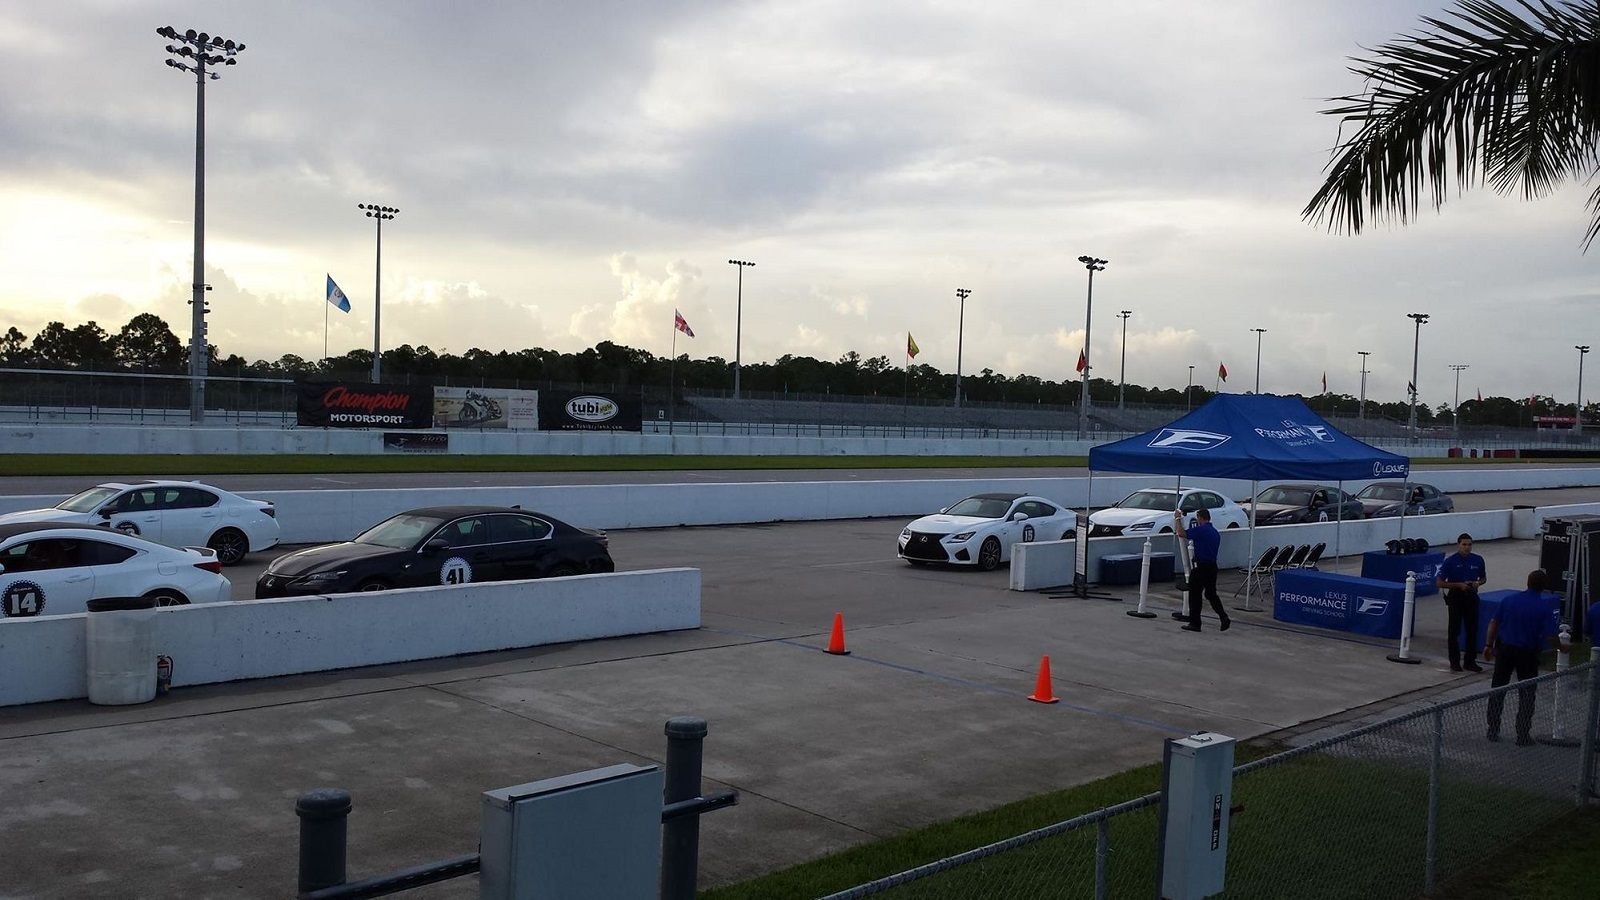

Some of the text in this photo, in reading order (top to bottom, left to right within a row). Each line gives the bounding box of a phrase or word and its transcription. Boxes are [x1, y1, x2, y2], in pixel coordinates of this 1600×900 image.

[323, 386, 409, 414] Champion
[571, 401, 599, 414] tubi
[330, 413, 404, 424] MOTORSPORT
[1381, 464, 1405, 474] LEXUS
[1024, 529, 1034, 542] 15
[446, 567, 464, 585] 41
[1280, 592, 1347, 610] PERFORMANCE
[1325, 591, 1347, 601] LEXUS
[11, 592, 37, 614] 14
